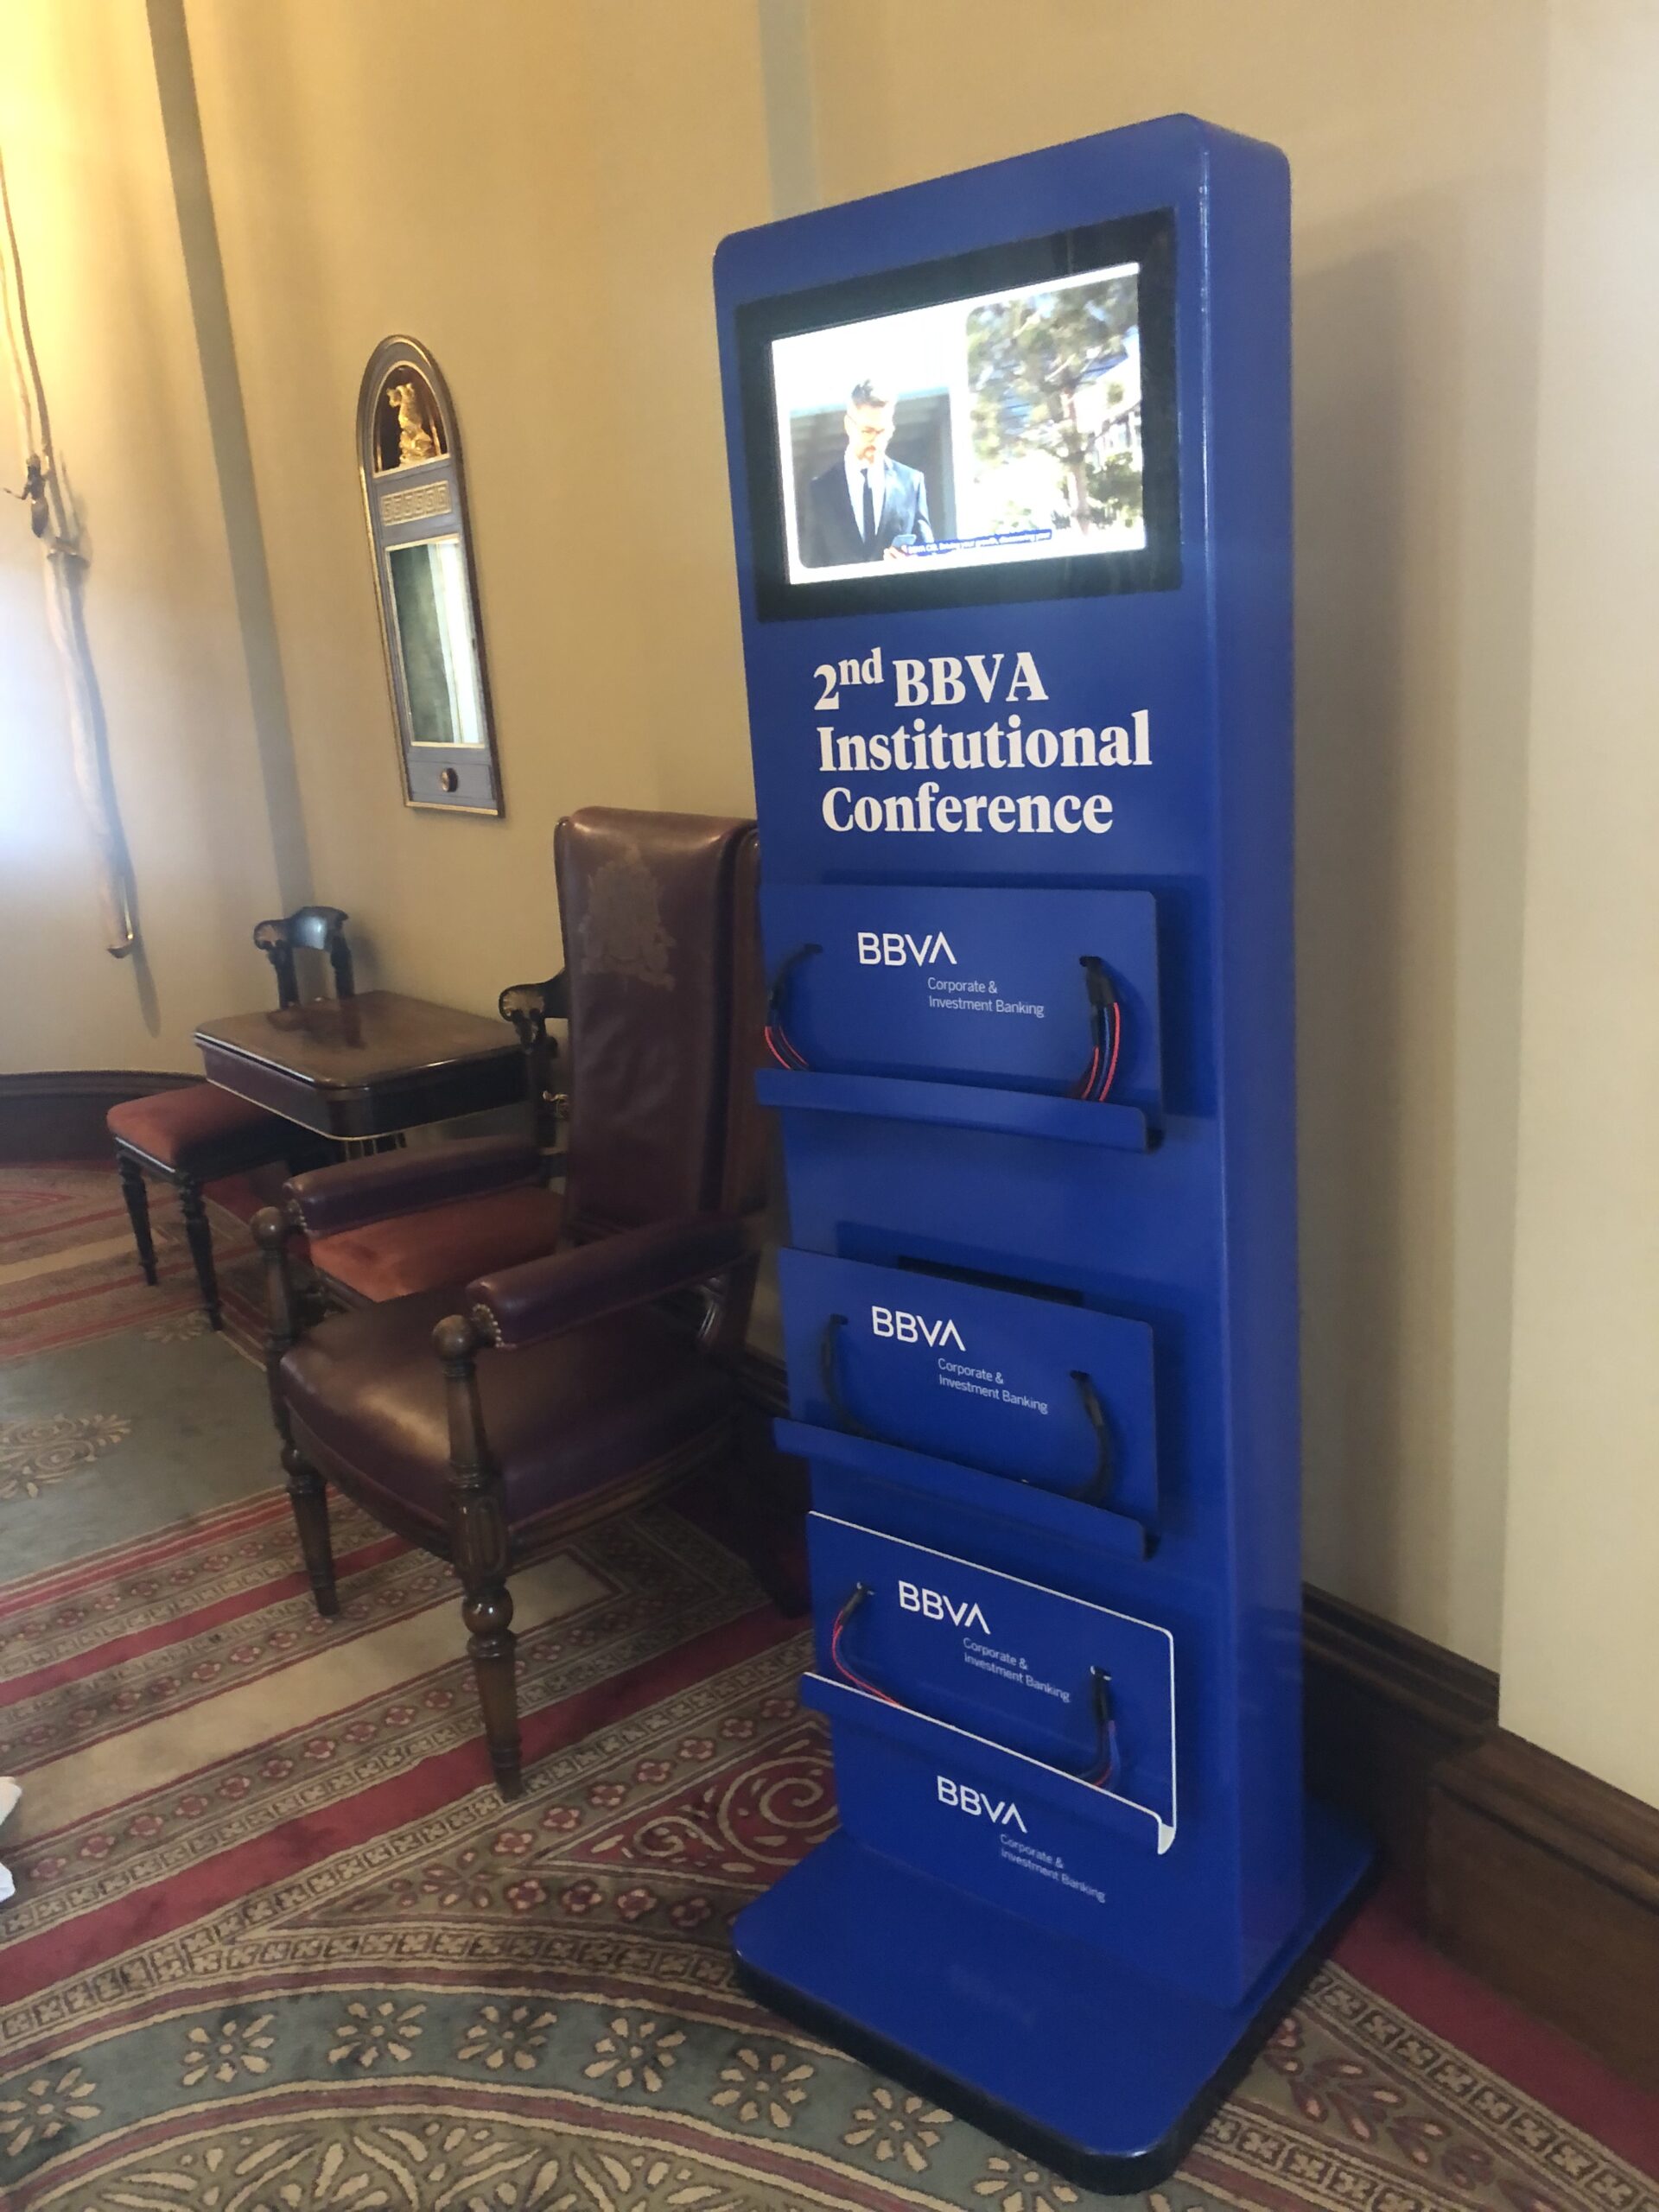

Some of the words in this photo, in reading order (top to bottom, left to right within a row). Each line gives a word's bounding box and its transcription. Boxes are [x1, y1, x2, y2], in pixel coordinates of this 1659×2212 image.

[814, 647, 884, 710] 2nd
[893, 652, 1049, 707] BBVA
[816, 709, 1153, 771] Institutional
[822, 781, 1114, 834] Conference
[857, 931, 957, 967] BBVA
[927, 977, 986, 994] Corporate
[988, 980, 998, 994] &
[929, 995, 993, 1012] Investment
[995, 999, 1045, 1018] Banking
[872, 1306, 966, 1351] BBVA
[938, 1357, 993, 1382] Corporate
[995, 1371, 1004, 1384] &
[938, 1374, 1000, 1400] Investment
[1002, 1389, 1048, 1414] Banking
[899, 1580, 991, 1635] BBVA
[963, 1637, 1017, 1665] Corporate
[1019, 1657, 1028, 1670] &
[964, 1652, 1023, 1683] Investment
[1026, 1675, 1071, 1703] Banking
[937, 1775, 1027, 1834] BBVA
[1000, 1834, 1053, 1864] Corporate
[1055, 1857, 1065, 1869] &
[1001, 1847, 1059, 1881] Investment
[1061, 1873, 1106, 1904] Banking
